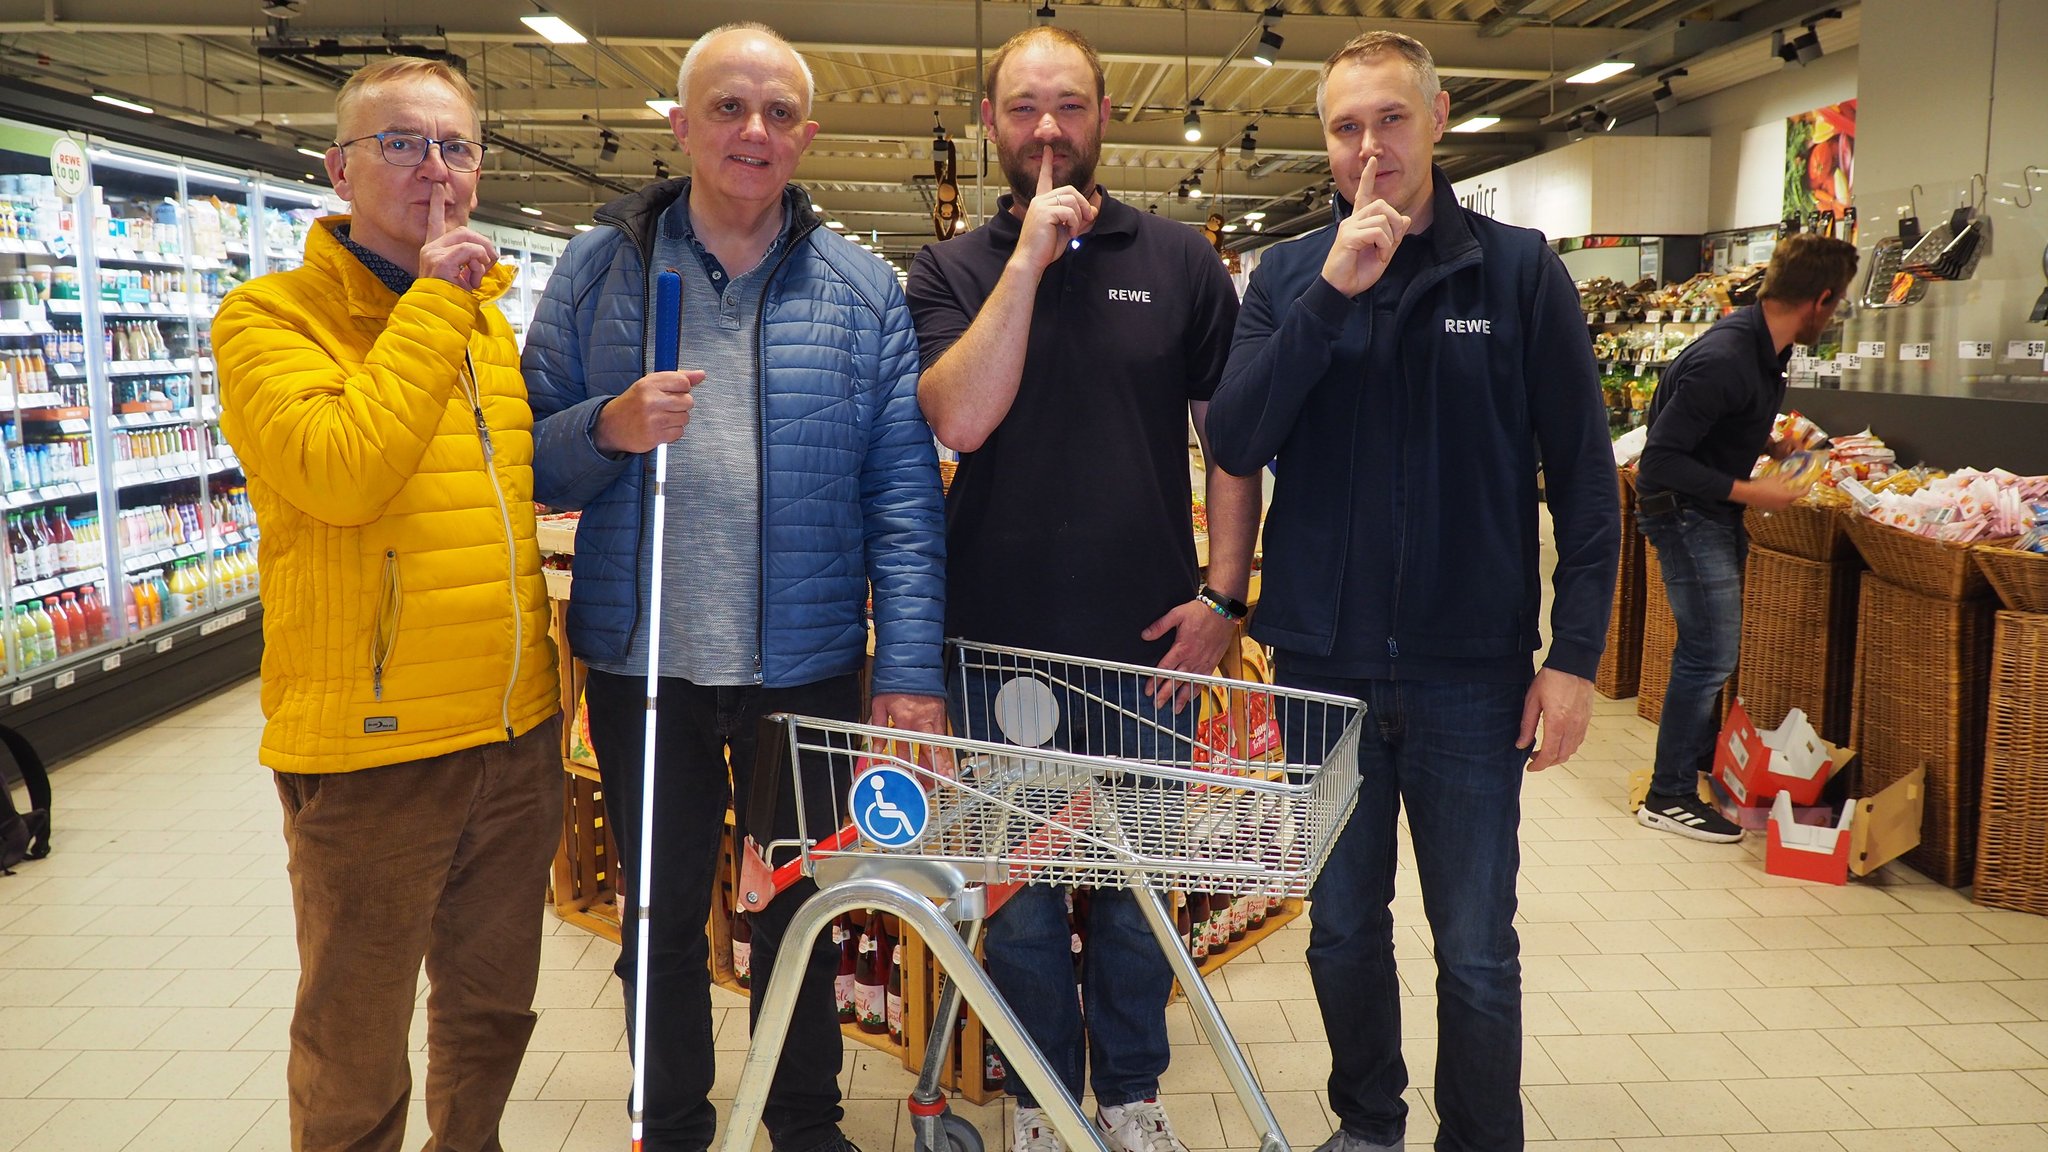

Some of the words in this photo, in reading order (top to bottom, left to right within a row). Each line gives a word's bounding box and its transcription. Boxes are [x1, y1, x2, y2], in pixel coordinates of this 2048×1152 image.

[60, 154, 81, 167] REWE
[56, 163, 66, 179] to
[68, 168, 80, 184] go
[1108, 288, 1152, 303] REWE
[1444, 318, 1491, 335] REWE
